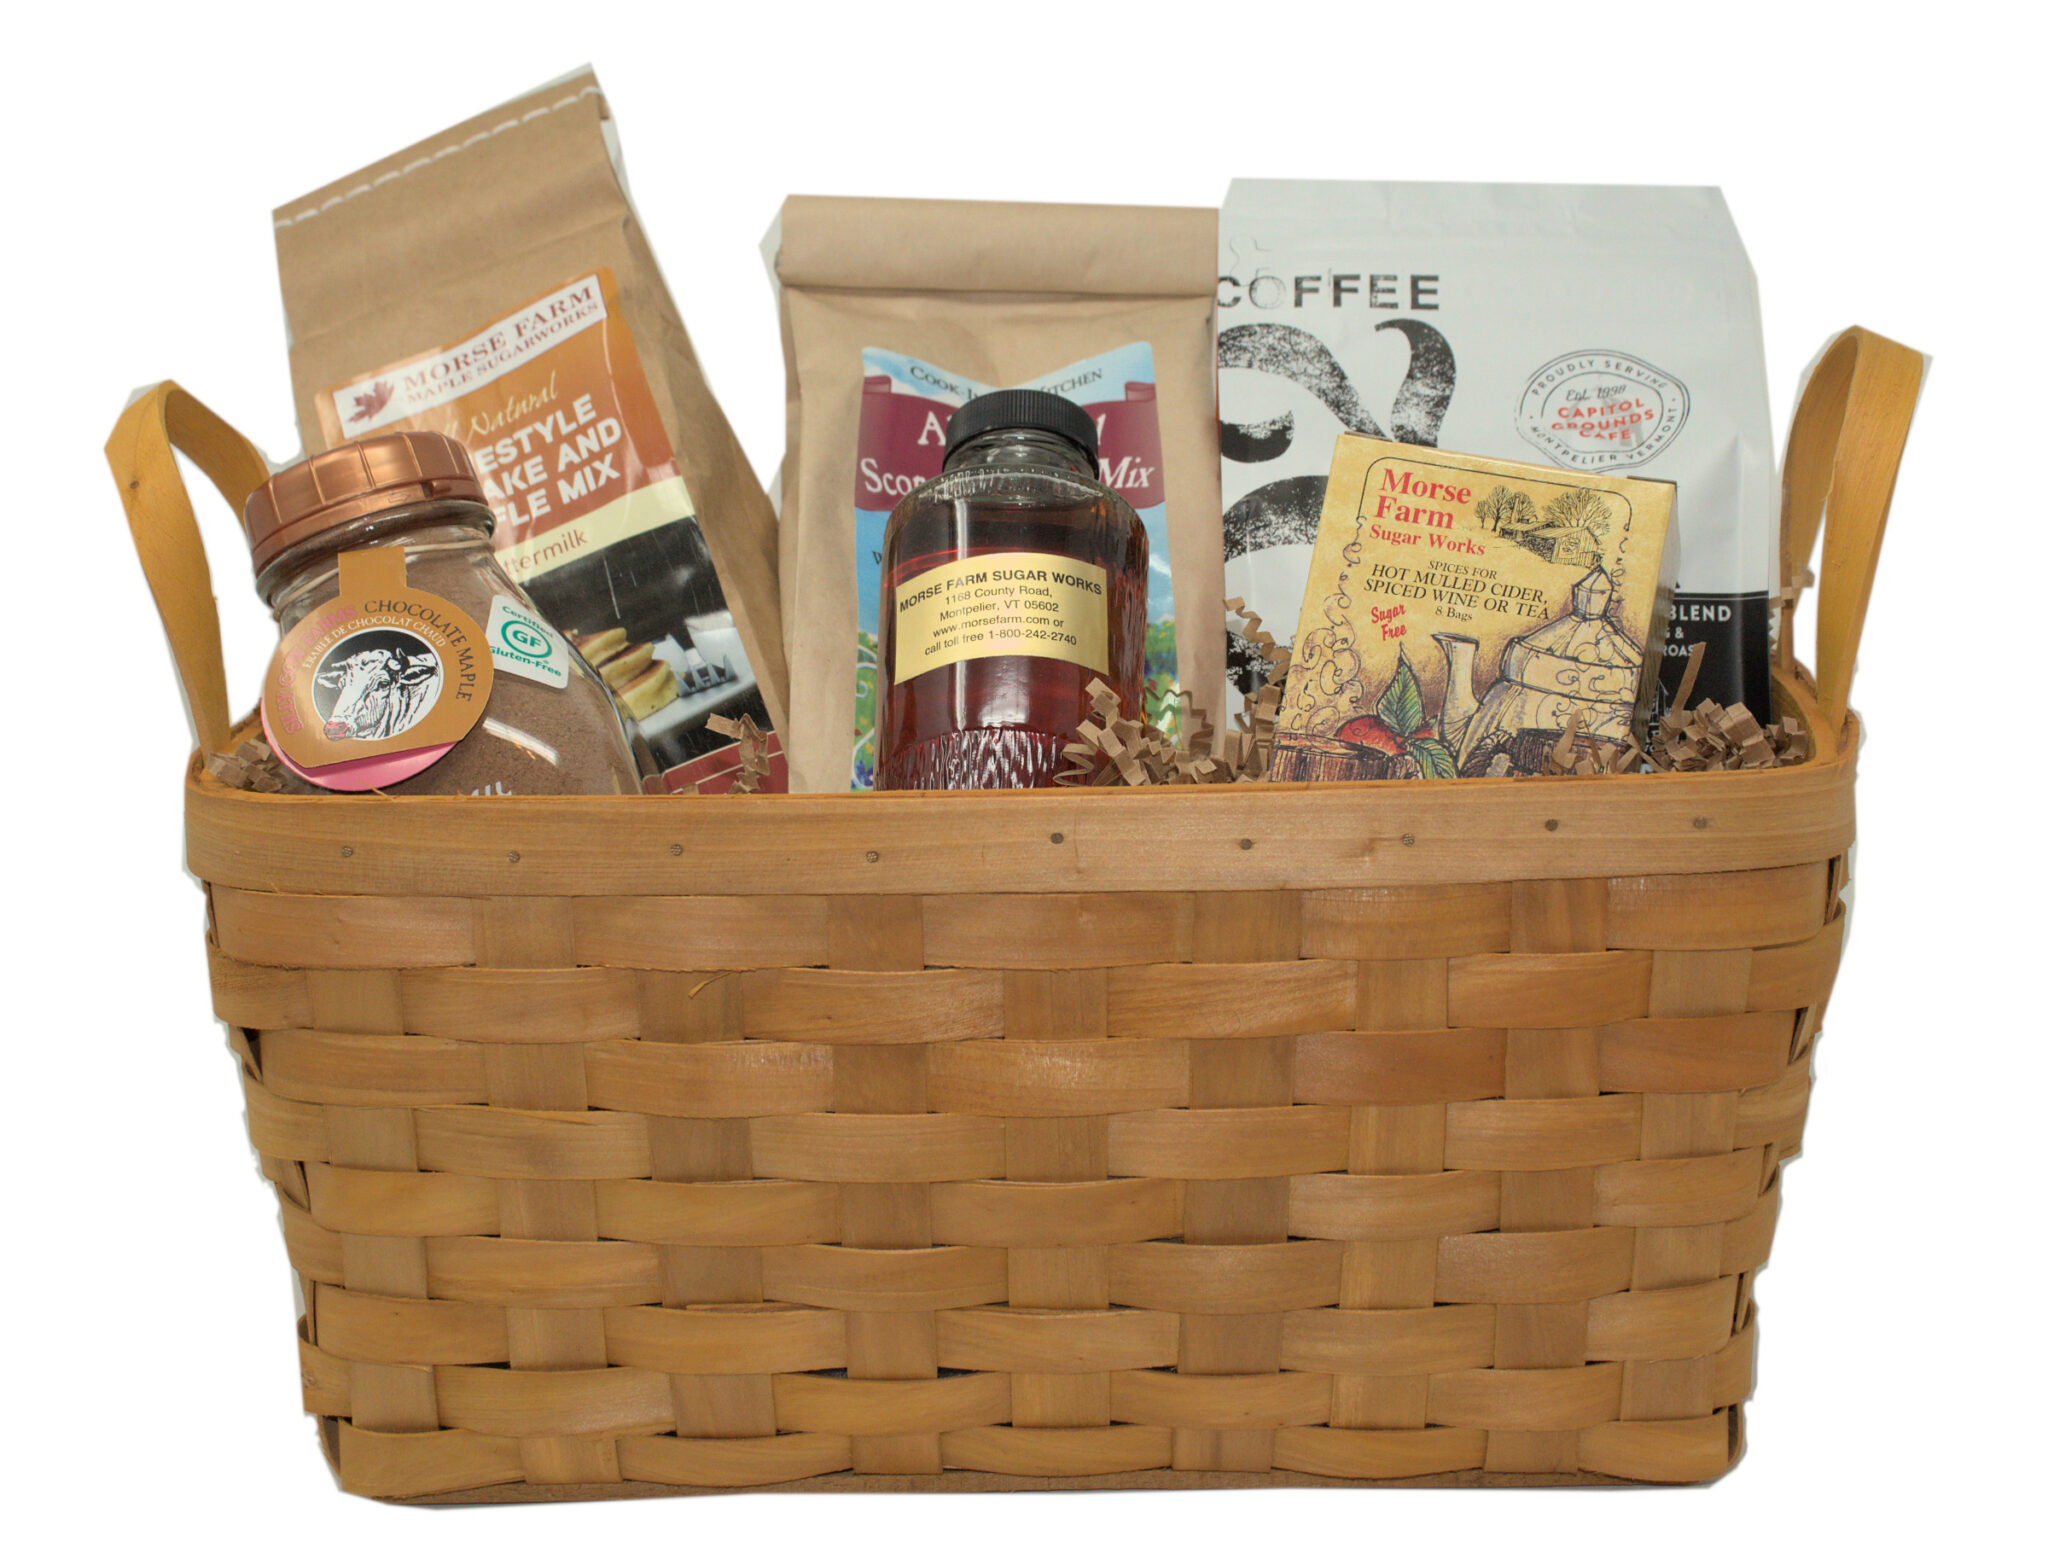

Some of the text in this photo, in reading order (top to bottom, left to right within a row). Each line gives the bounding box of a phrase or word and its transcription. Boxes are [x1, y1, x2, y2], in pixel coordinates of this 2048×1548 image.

[1218, 273, 1440, 310] COFFEE
[403, 286, 593, 392] MORSE FARM
[407, 301, 599, 403] MAPLE SUGARWORKS
[909, 366, 979, 401] COOK-I
[1531, 359, 1669, 397] PROUDLY SERVING
[466, 370, 559, 443] Natural
[1551, 409, 1655, 432] GROUNDS
[1557, 398, 1645, 419] CAPITOL
[474, 393, 597, 474] ESTYLE
[1530, 407, 1678, 465] MONTPELIER VERMONT
[1578, 428, 1632, 441] CAFE
[483, 417, 622, 499] AKE AND
[1098, 456, 1154, 489] Mix
[495, 453, 621, 527] FLE MIX
[1379, 468, 1472, 504] Morse
[1374, 495, 1455, 530] Farm
[503, 529, 588, 574] ttermilk
[1369, 523, 1487, 556] Sugar Works
[1371, 563, 1549, 604] HOT MULLED CIDER,
[1428, 560, 1498, 580] SPICES FOR
[899, 569, 1103, 613] MORSE FARM SUGAR WORKS
[945, 585, 1053, 605] 1168 County Road,
[1363, 578, 1551, 620] SPICED WINE OR TEA
[301, 605, 358, 646] FARMS
[502, 605, 553, 639] Certified
[932, 615, 1065, 638] www.morsefarm.com or
[939, 600, 1060, 622] Montpelier, VT 05602
[1371, 604, 1407, 624] Sugar
[1435, 606, 1473, 622] 8 Bags
[332, 625, 348, 639] DE
[347, 615, 413, 631] CHOCOLAT
[413, 621, 447, 647] CHAUD
[512, 630, 542, 648] GF
[924, 629, 1078, 656] call toll free 1-800-242-2740
[1381, 623, 1407, 641] Free
[364, 599, 476, 702] CHOCOLATE MAPLE
[1662, 644, 1694, 657] ROAS
